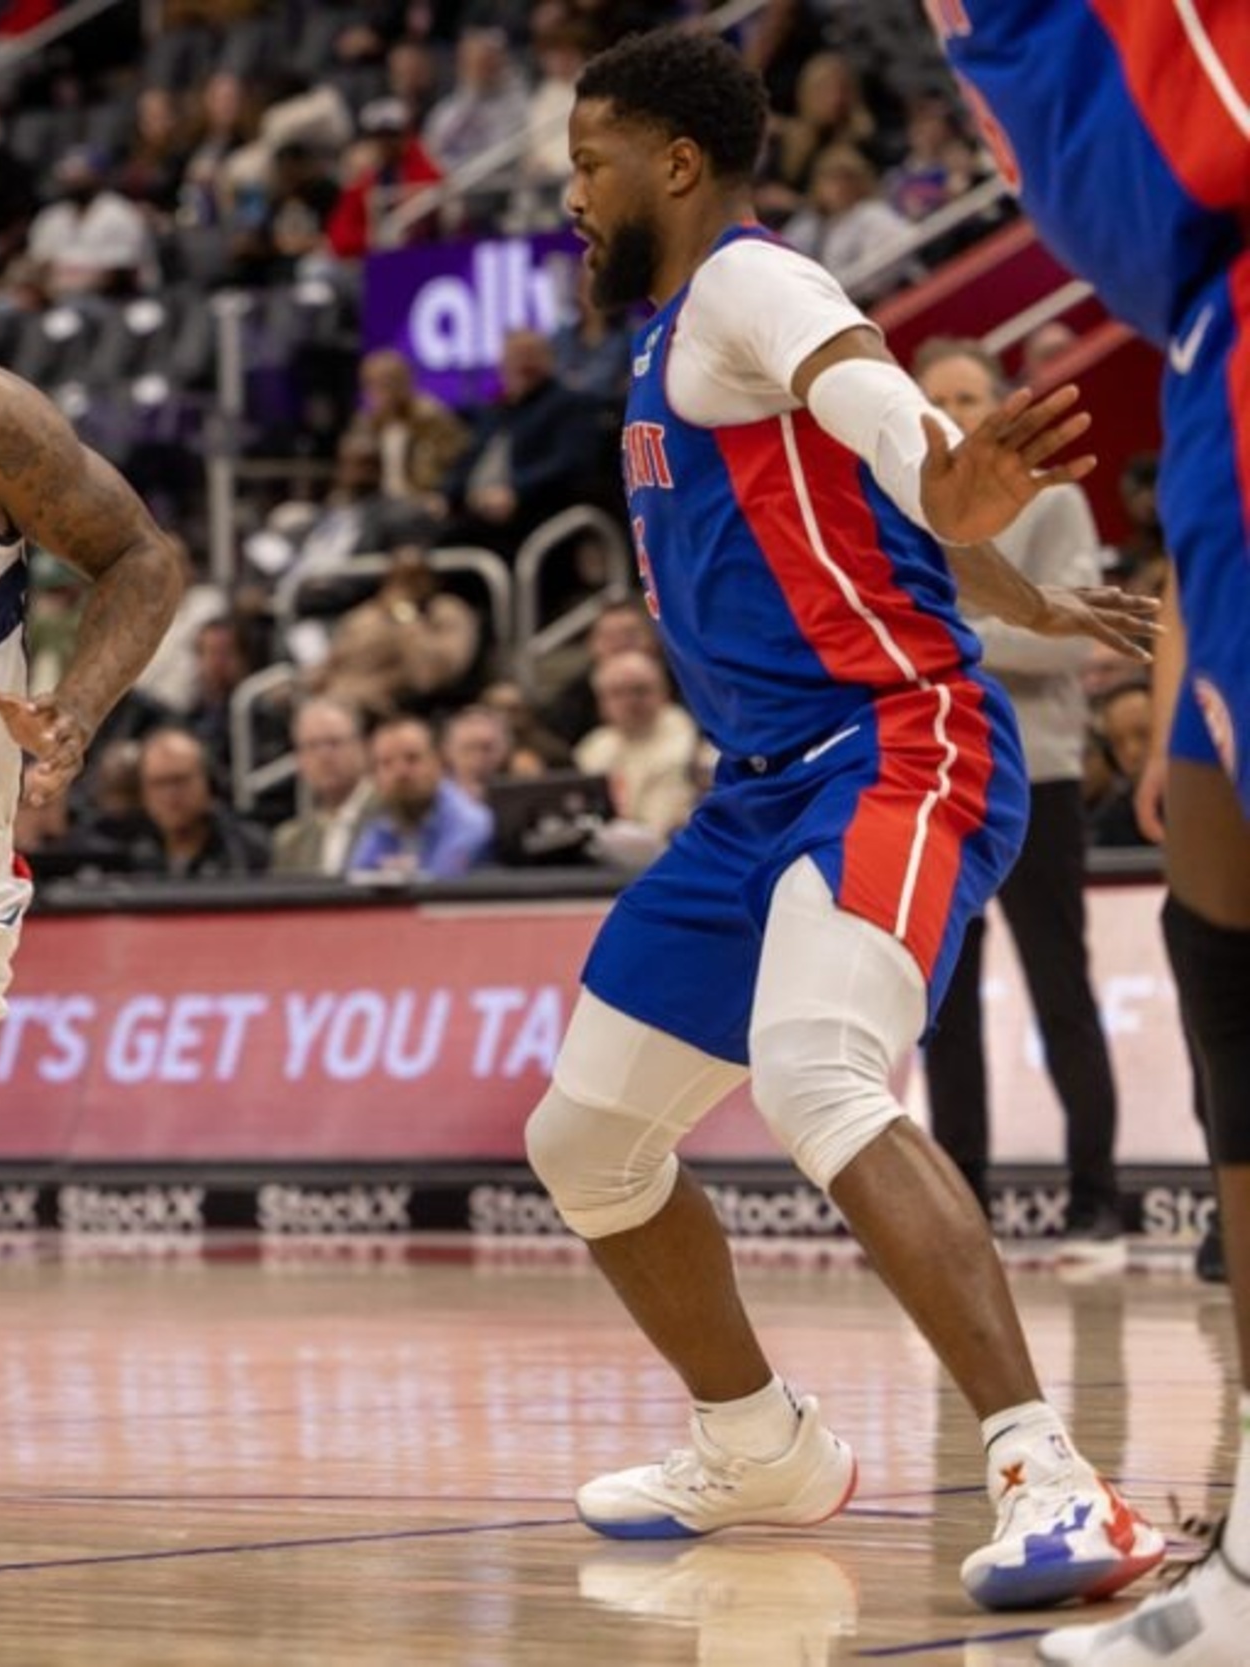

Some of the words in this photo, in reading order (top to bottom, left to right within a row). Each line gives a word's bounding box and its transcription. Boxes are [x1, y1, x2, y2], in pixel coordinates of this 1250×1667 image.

[104, 993, 271, 1083] GET
[284, 988, 452, 1082] YOU
[57, 1185, 205, 1232] StockX
[256, 1184, 411, 1232] StockX
